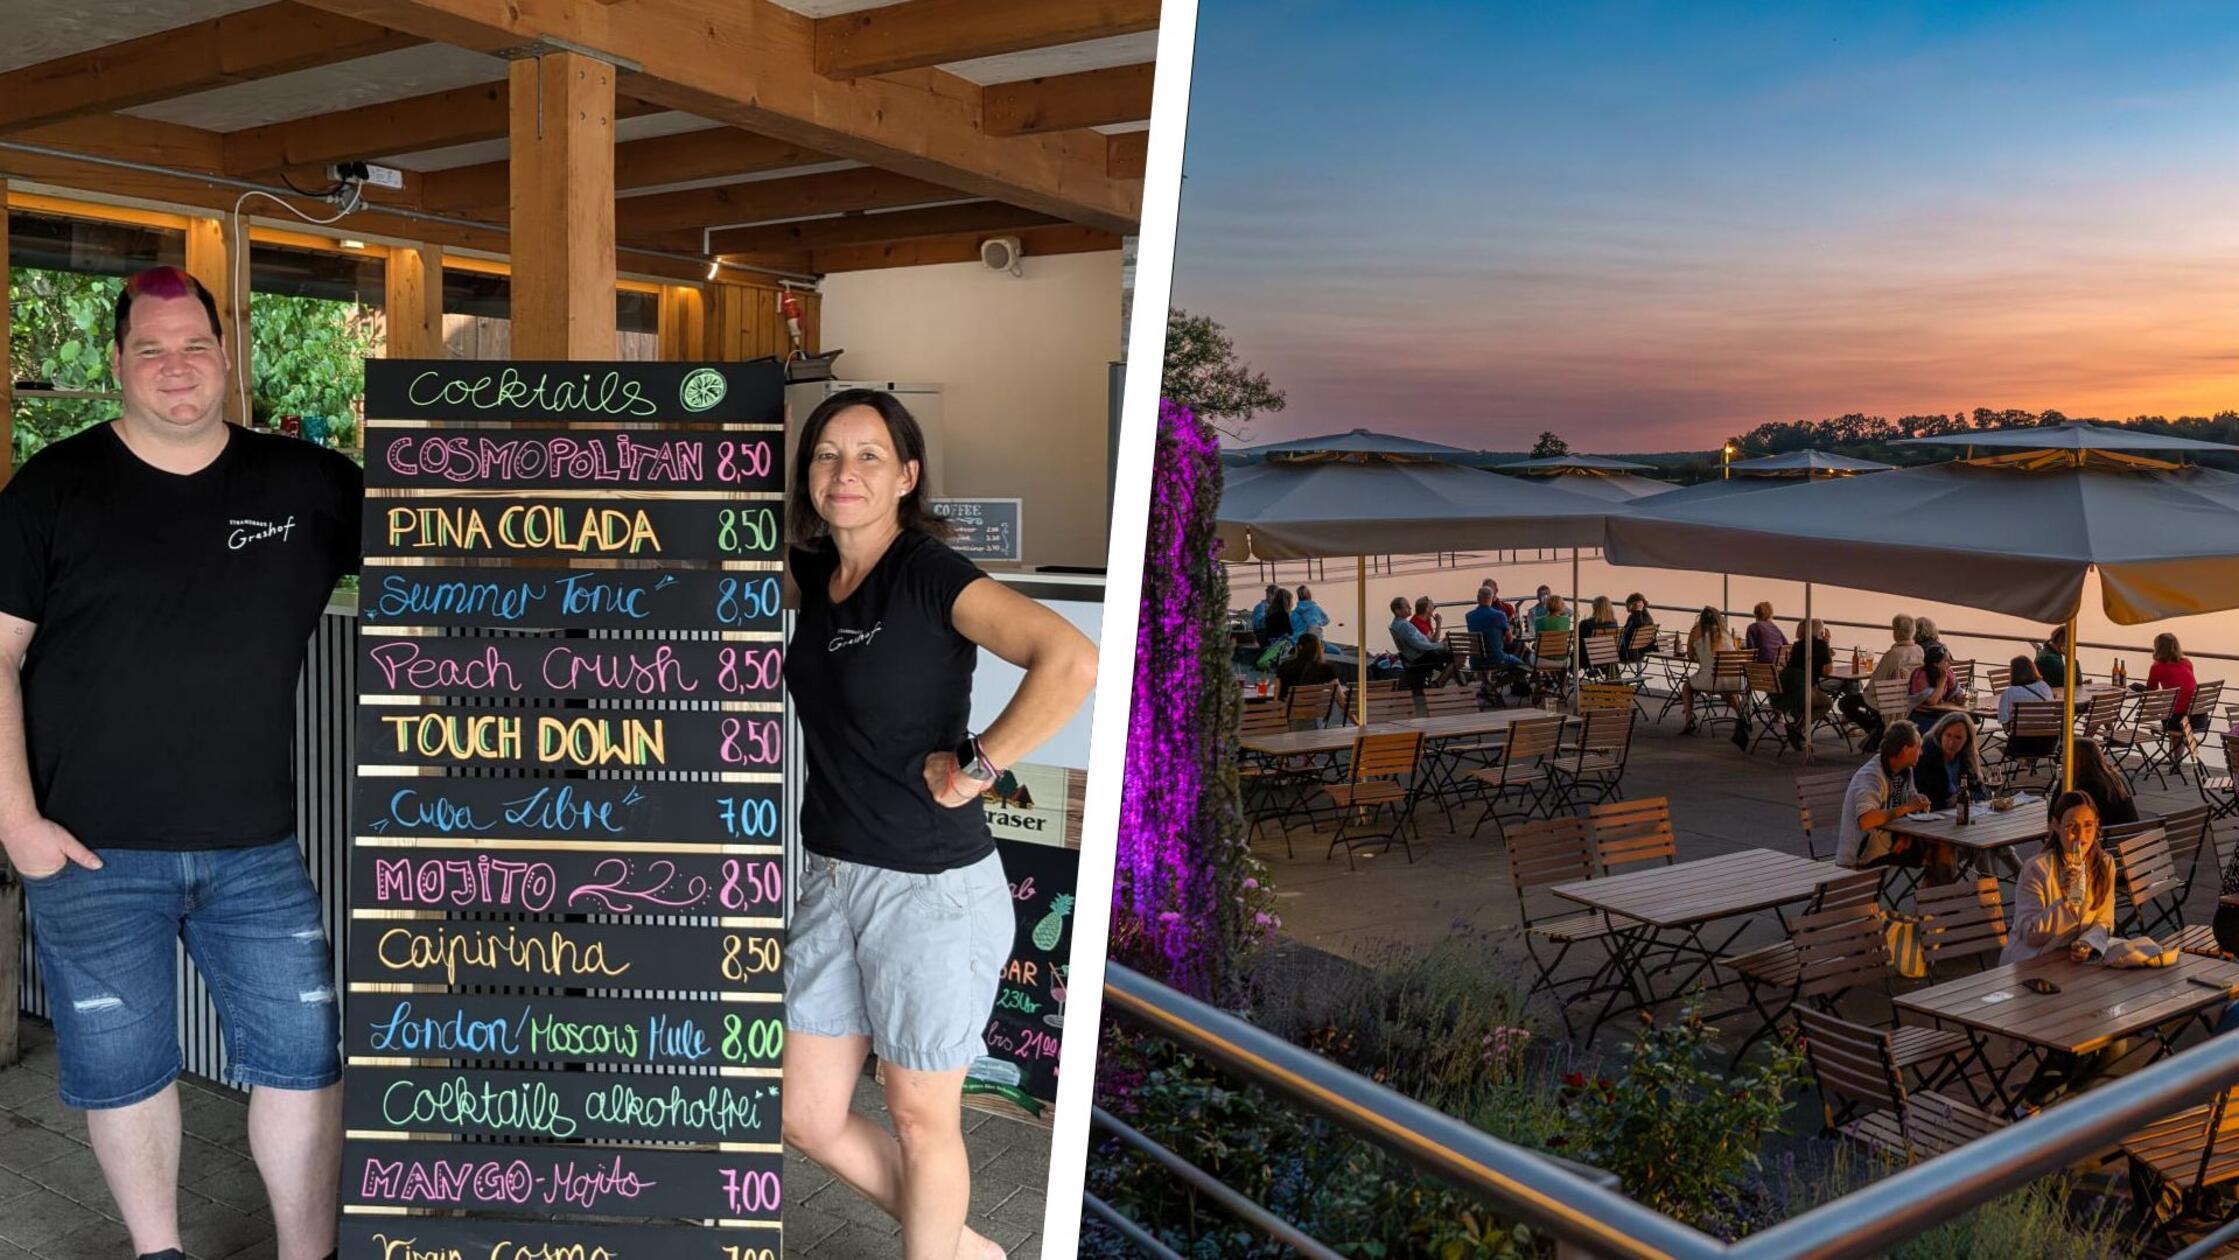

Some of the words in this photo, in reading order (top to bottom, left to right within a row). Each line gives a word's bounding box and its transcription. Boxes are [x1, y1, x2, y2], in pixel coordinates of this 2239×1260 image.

[409, 368, 657, 416] Cocktails
[717, 441, 772, 484] 8,50
[228, 515, 296, 549] Grashof
[388, 506, 493, 550] PINA
[499, 504, 662, 554] COLADA
[718, 508, 777, 554] 8,50
[933, 503, 983, 517] COFFEE
[379, 575, 547, 620] Summer
[555, 572, 651, 619] Tonic
[716, 577, 781, 626] 8,50
[370, 642, 522, 691] Peach
[543, 645, 699, 694] Crush
[719, 647, 782, 695] 8,50
[381, 712, 522, 760] TOUCH
[538, 715, 666, 766] DOWN
[721, 718, 780, 766] 8,50
[391, 789, 497, 832] Cuba
[717, 798, 777, 839] 7,00
[986, 810, 1047, 832] raser
[720, 858, 781, 912] 8,50
[378, 925, 631, 986] Caipirinha
[721, 934, 780, 983] 8,50
[721, 1013, 783, 1064] 8,00
[383, 1076, 577, 1138] Cocktails
[719, 1168, 781, 1215] 7,00
